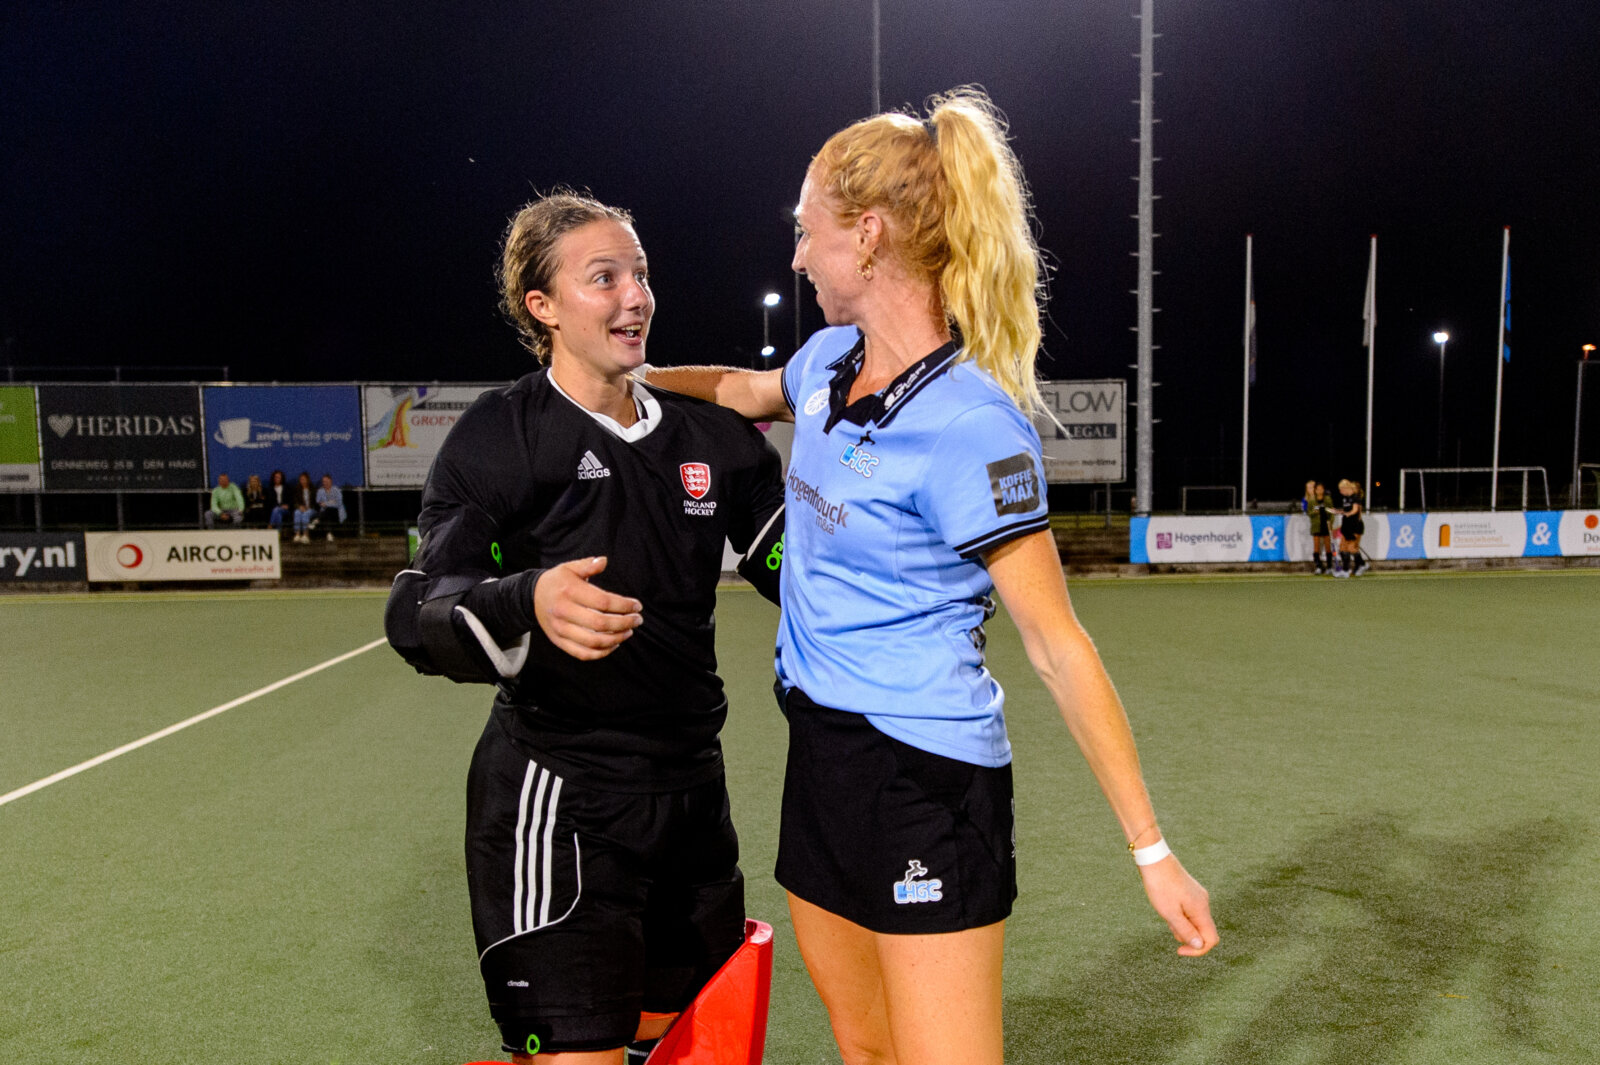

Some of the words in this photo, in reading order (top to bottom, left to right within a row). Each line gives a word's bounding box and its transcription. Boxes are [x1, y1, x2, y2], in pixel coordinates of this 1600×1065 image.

[76, 415, 195, 436] HERIDAS
[411, 415, 460, 426] GROEN
[840, 443, 880, 478] HGC
[577, 467, 611, 480] adidas
[998, 469, 1033, 490] KOFFIE
[683, 500, 717, 509] ENGLAND
[787, 467, 851, 528] Hogenhouck
[1002, 481, 1035, 507] MAX
[684, 507, 715, 516] HOCKEY
[1175, 532, 1243, 545] Hogenhouck
[1583, 533, 1600, 544] Do
[0, 541, 76, 577] ry.nl
[894, 879, 943, 904] HGC
